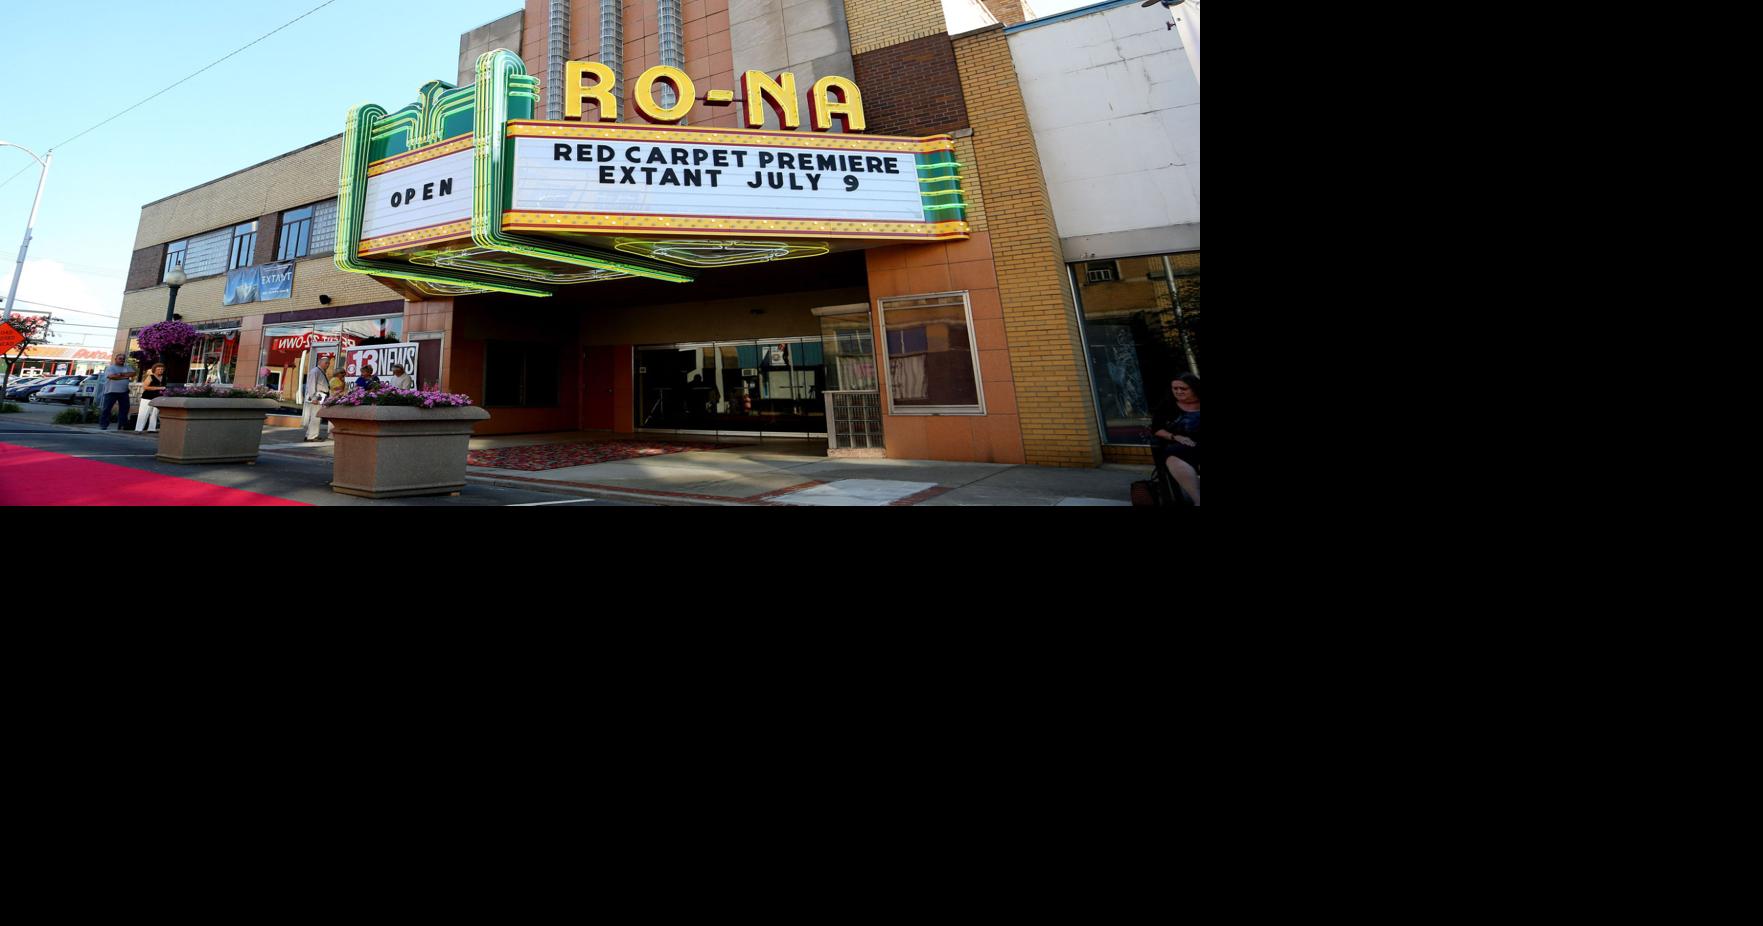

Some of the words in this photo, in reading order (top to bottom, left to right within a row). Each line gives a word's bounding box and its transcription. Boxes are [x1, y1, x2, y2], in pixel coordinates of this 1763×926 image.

[564, 60, 866, 133] RO-NA
[553, 143, 615, 162] RED
[625, 146, 748, 168] CARPET
[758, 151, 900, 174] PREMIERE
[390, 177, 453, 208] OPEN
[599, 165, 722, 187] EXTANT
[747, 171, 821, 191] JULY
[843, 174, 860, 192] 9
[352, 349, 379, 376] 13
[378, 346, 415, 376] NEWS
